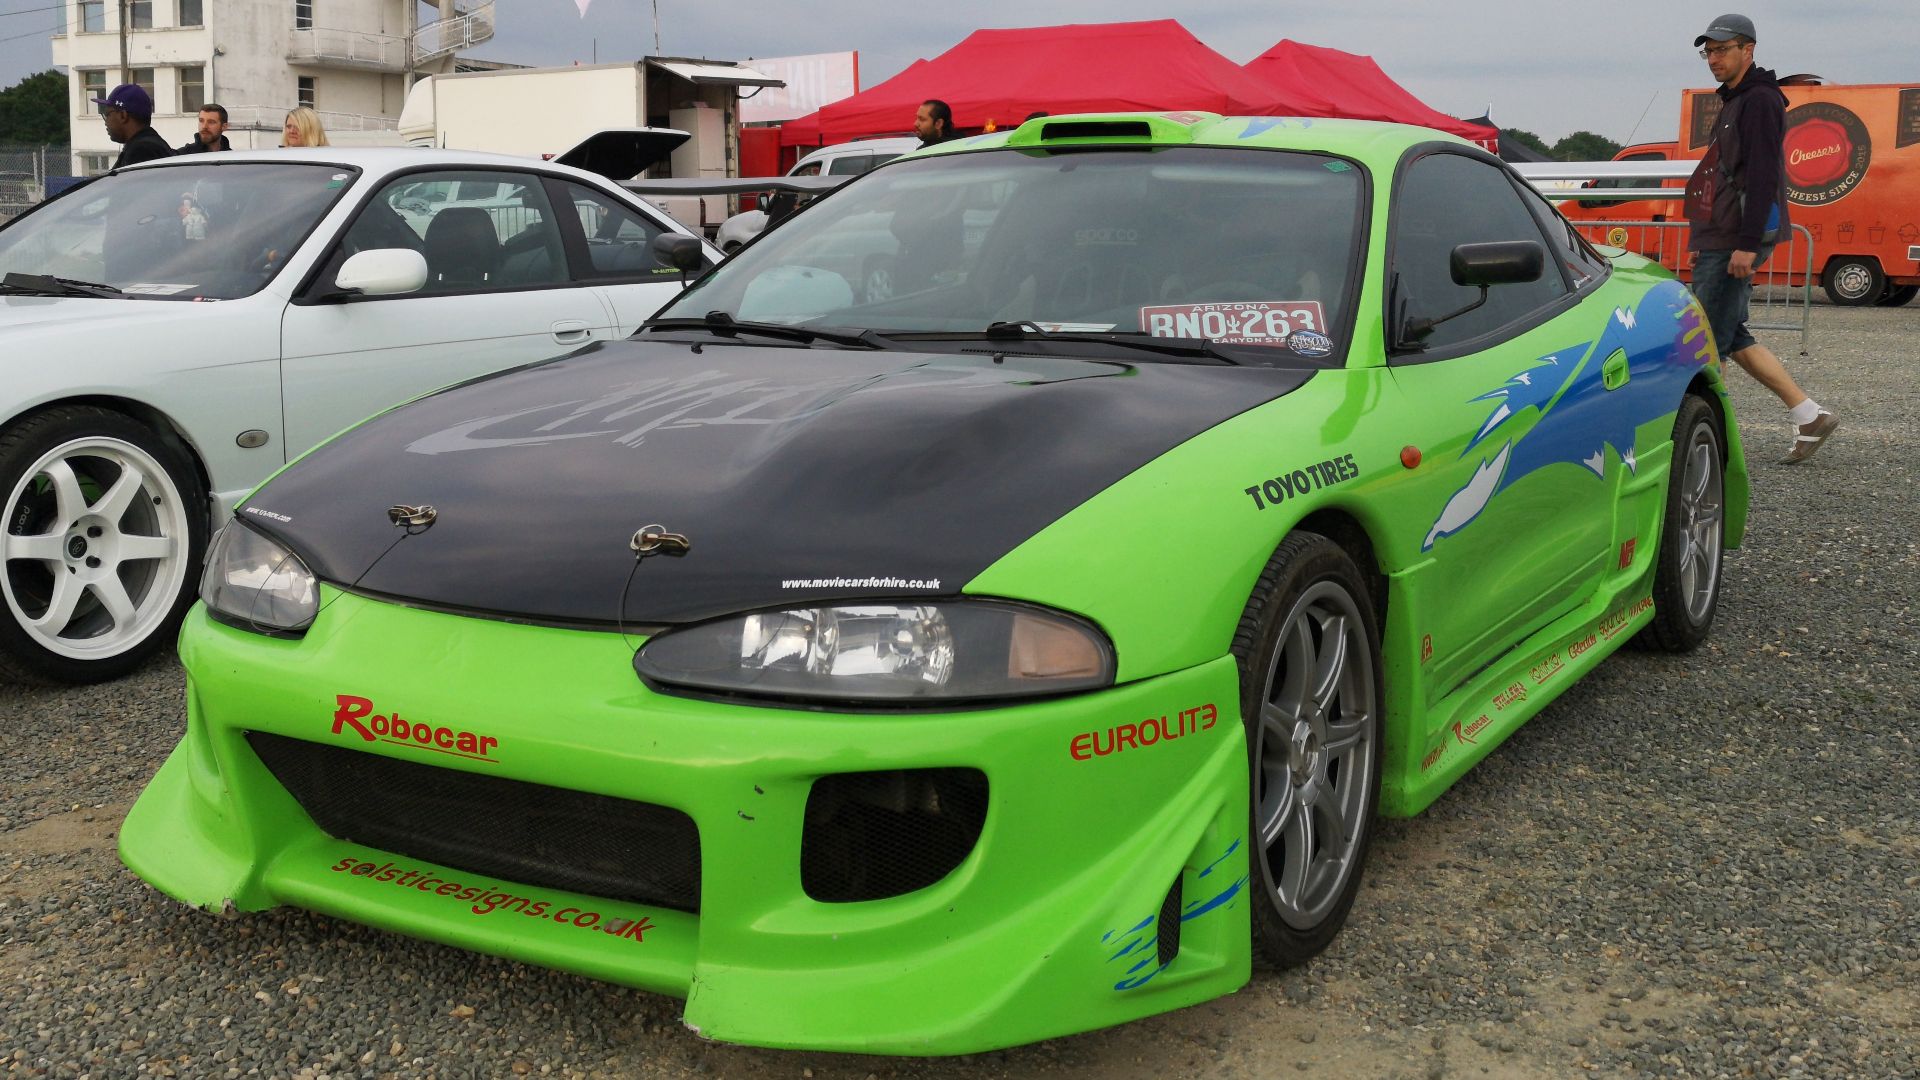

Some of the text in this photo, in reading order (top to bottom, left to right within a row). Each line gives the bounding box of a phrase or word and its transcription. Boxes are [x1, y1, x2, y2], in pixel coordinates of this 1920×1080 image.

[1790, 143, 1841, 165] Cheesers
[1828, 170, 1859, 198] SINCE
[1192, 303, 1270, 312] ARIZONA
[1240, 309, 1316, 338] 263
[1211, 336, 1262, 344] CANYON
[1244, 453, 1359, 511] TOYO TIRES
[781, 576, 941, 590] www.moviecarsforhire.co.uk
[331, 694, 499, 756] Robocar
[1451, 713, 1491, 745] Robocar
[331, 856, 657, 943] solsticesigns.co.uk
